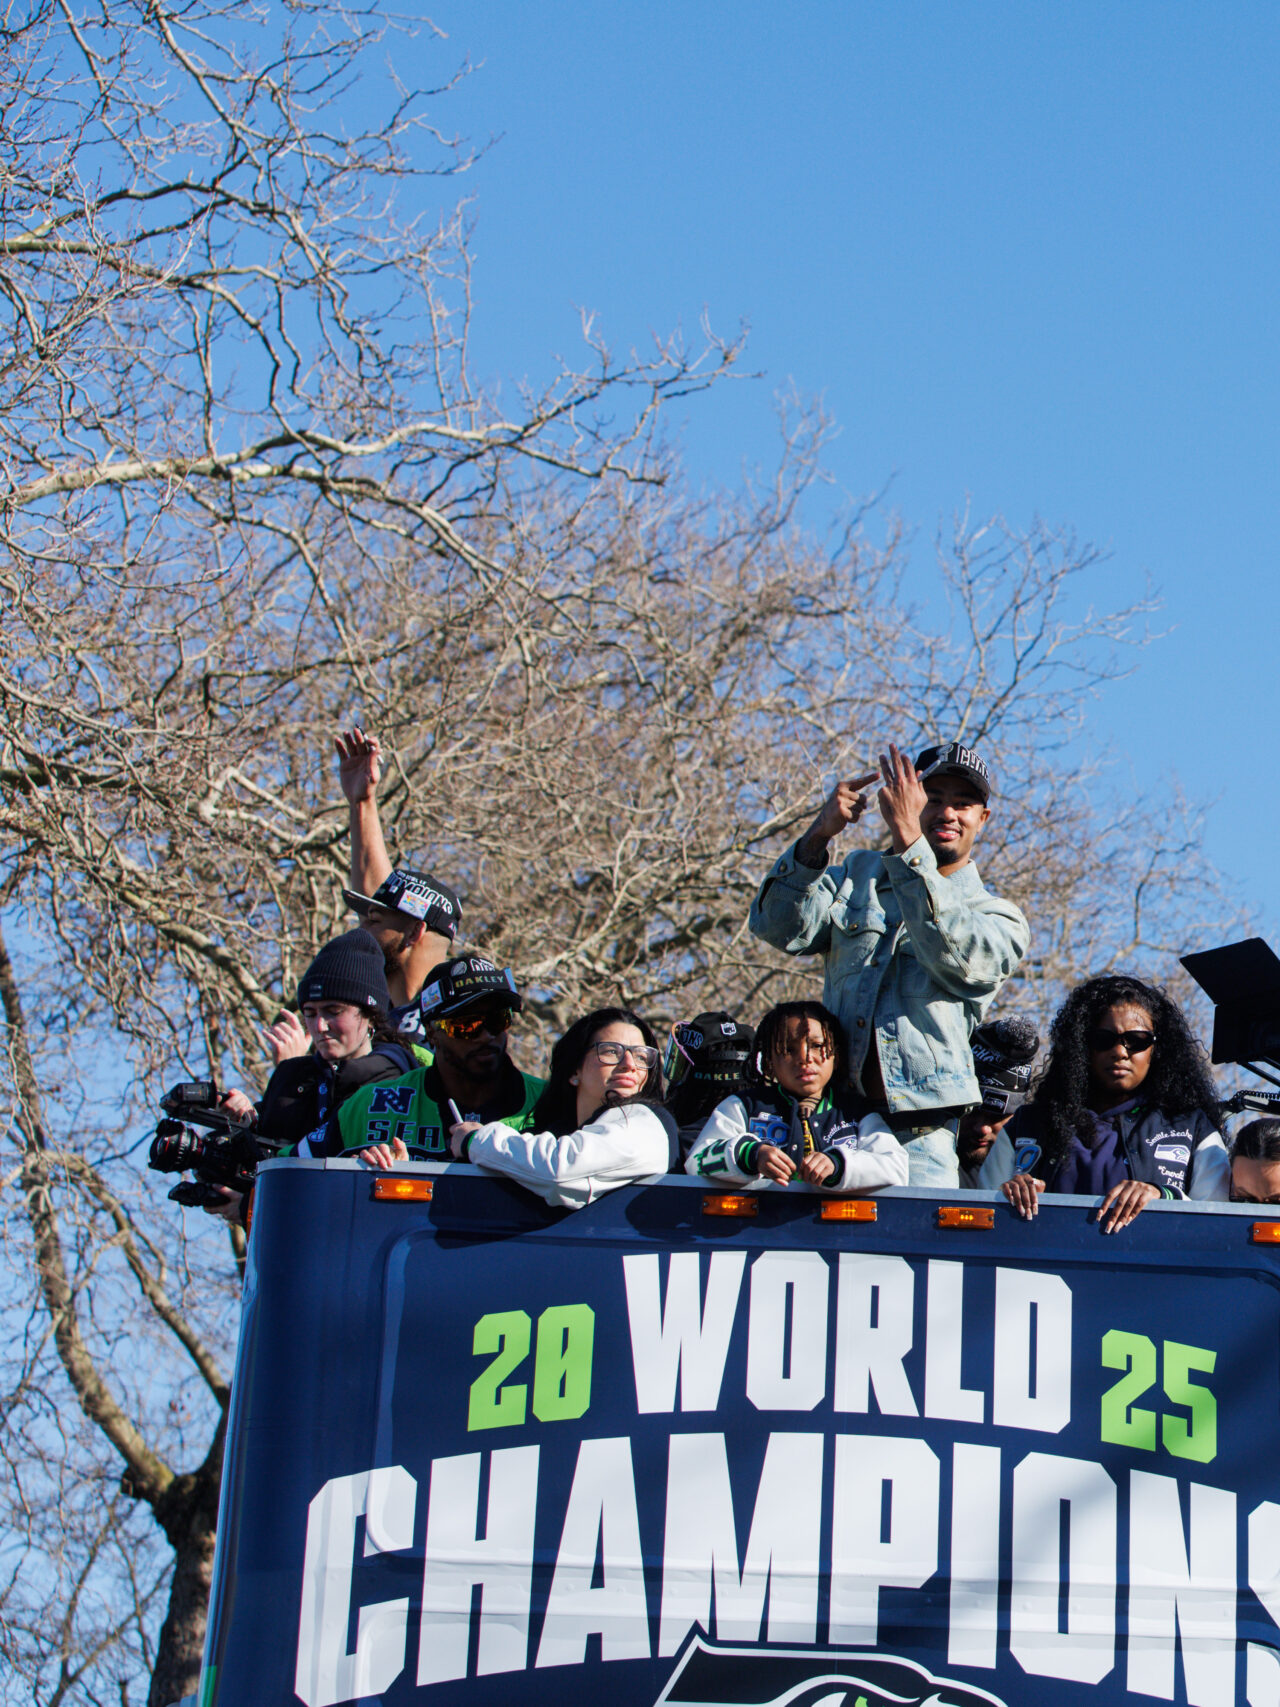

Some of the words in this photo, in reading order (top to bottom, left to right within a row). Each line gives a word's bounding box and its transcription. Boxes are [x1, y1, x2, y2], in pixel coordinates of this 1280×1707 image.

[455, 975, 504, 988] OAKLEY
[468, 1304, 595, 1432] 20
[622, 1251, 1073, 1434] WORLD
[1101, 1330, 1218, 1464] 25
